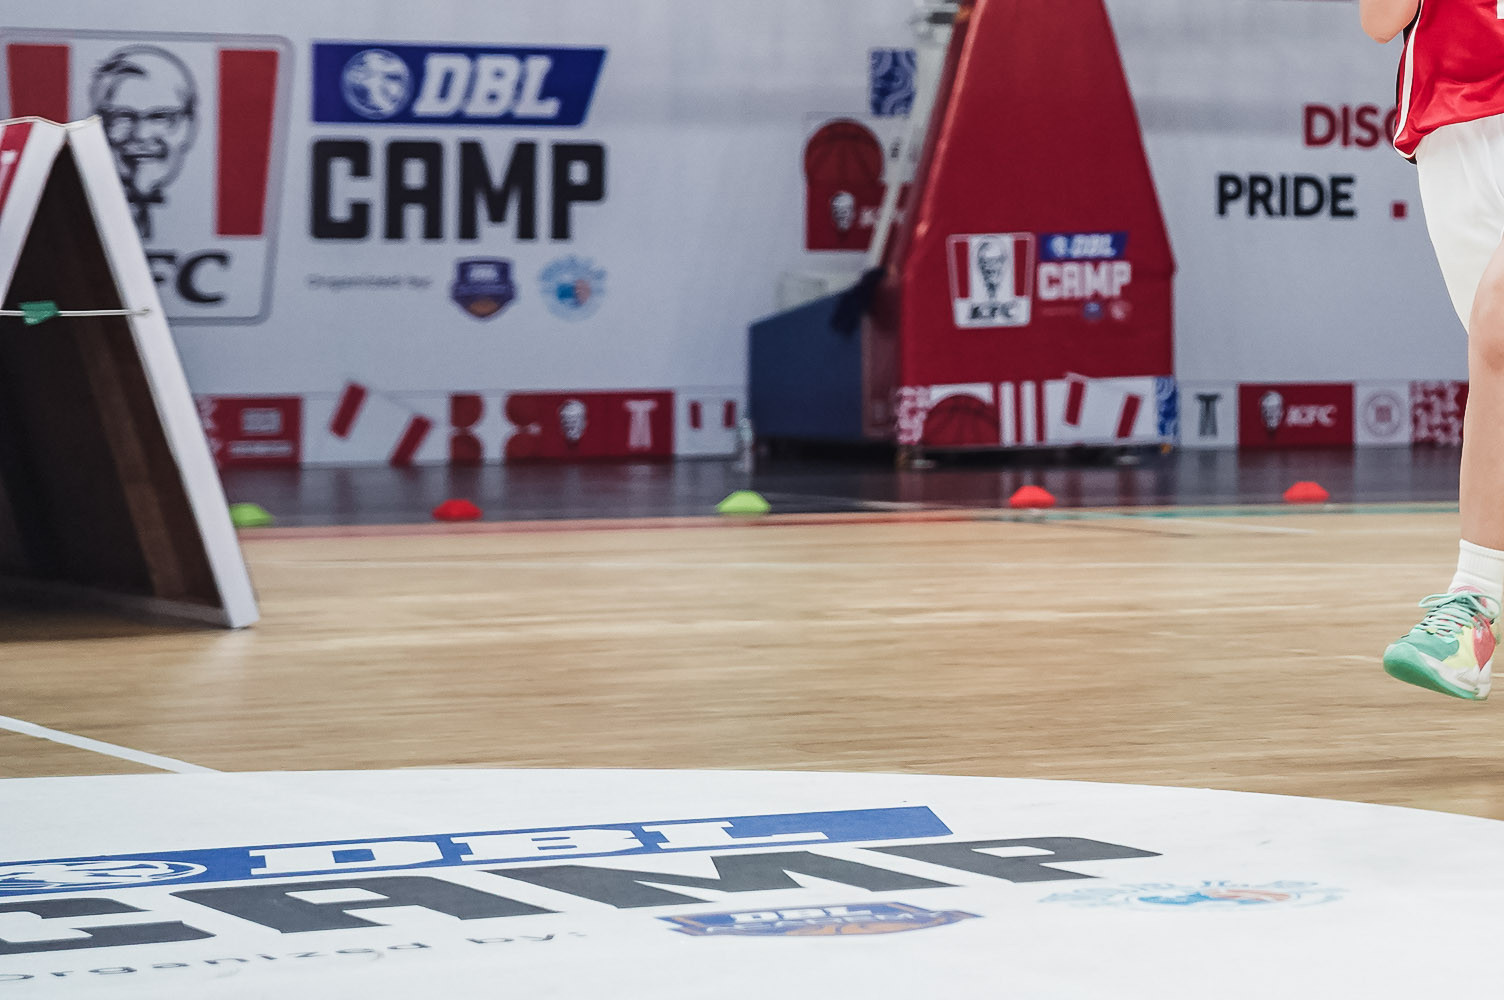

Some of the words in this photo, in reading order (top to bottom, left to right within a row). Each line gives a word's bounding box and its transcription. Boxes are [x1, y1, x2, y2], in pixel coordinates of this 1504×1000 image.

[412, 52, 562, 120] DBL
[310, 138, 607, 242] CAMP
[1217, 173, 1356, 218] PRIDE
[1037, 260, 1133, 301] CAMP
[250, 821, 828, 876] DBL
